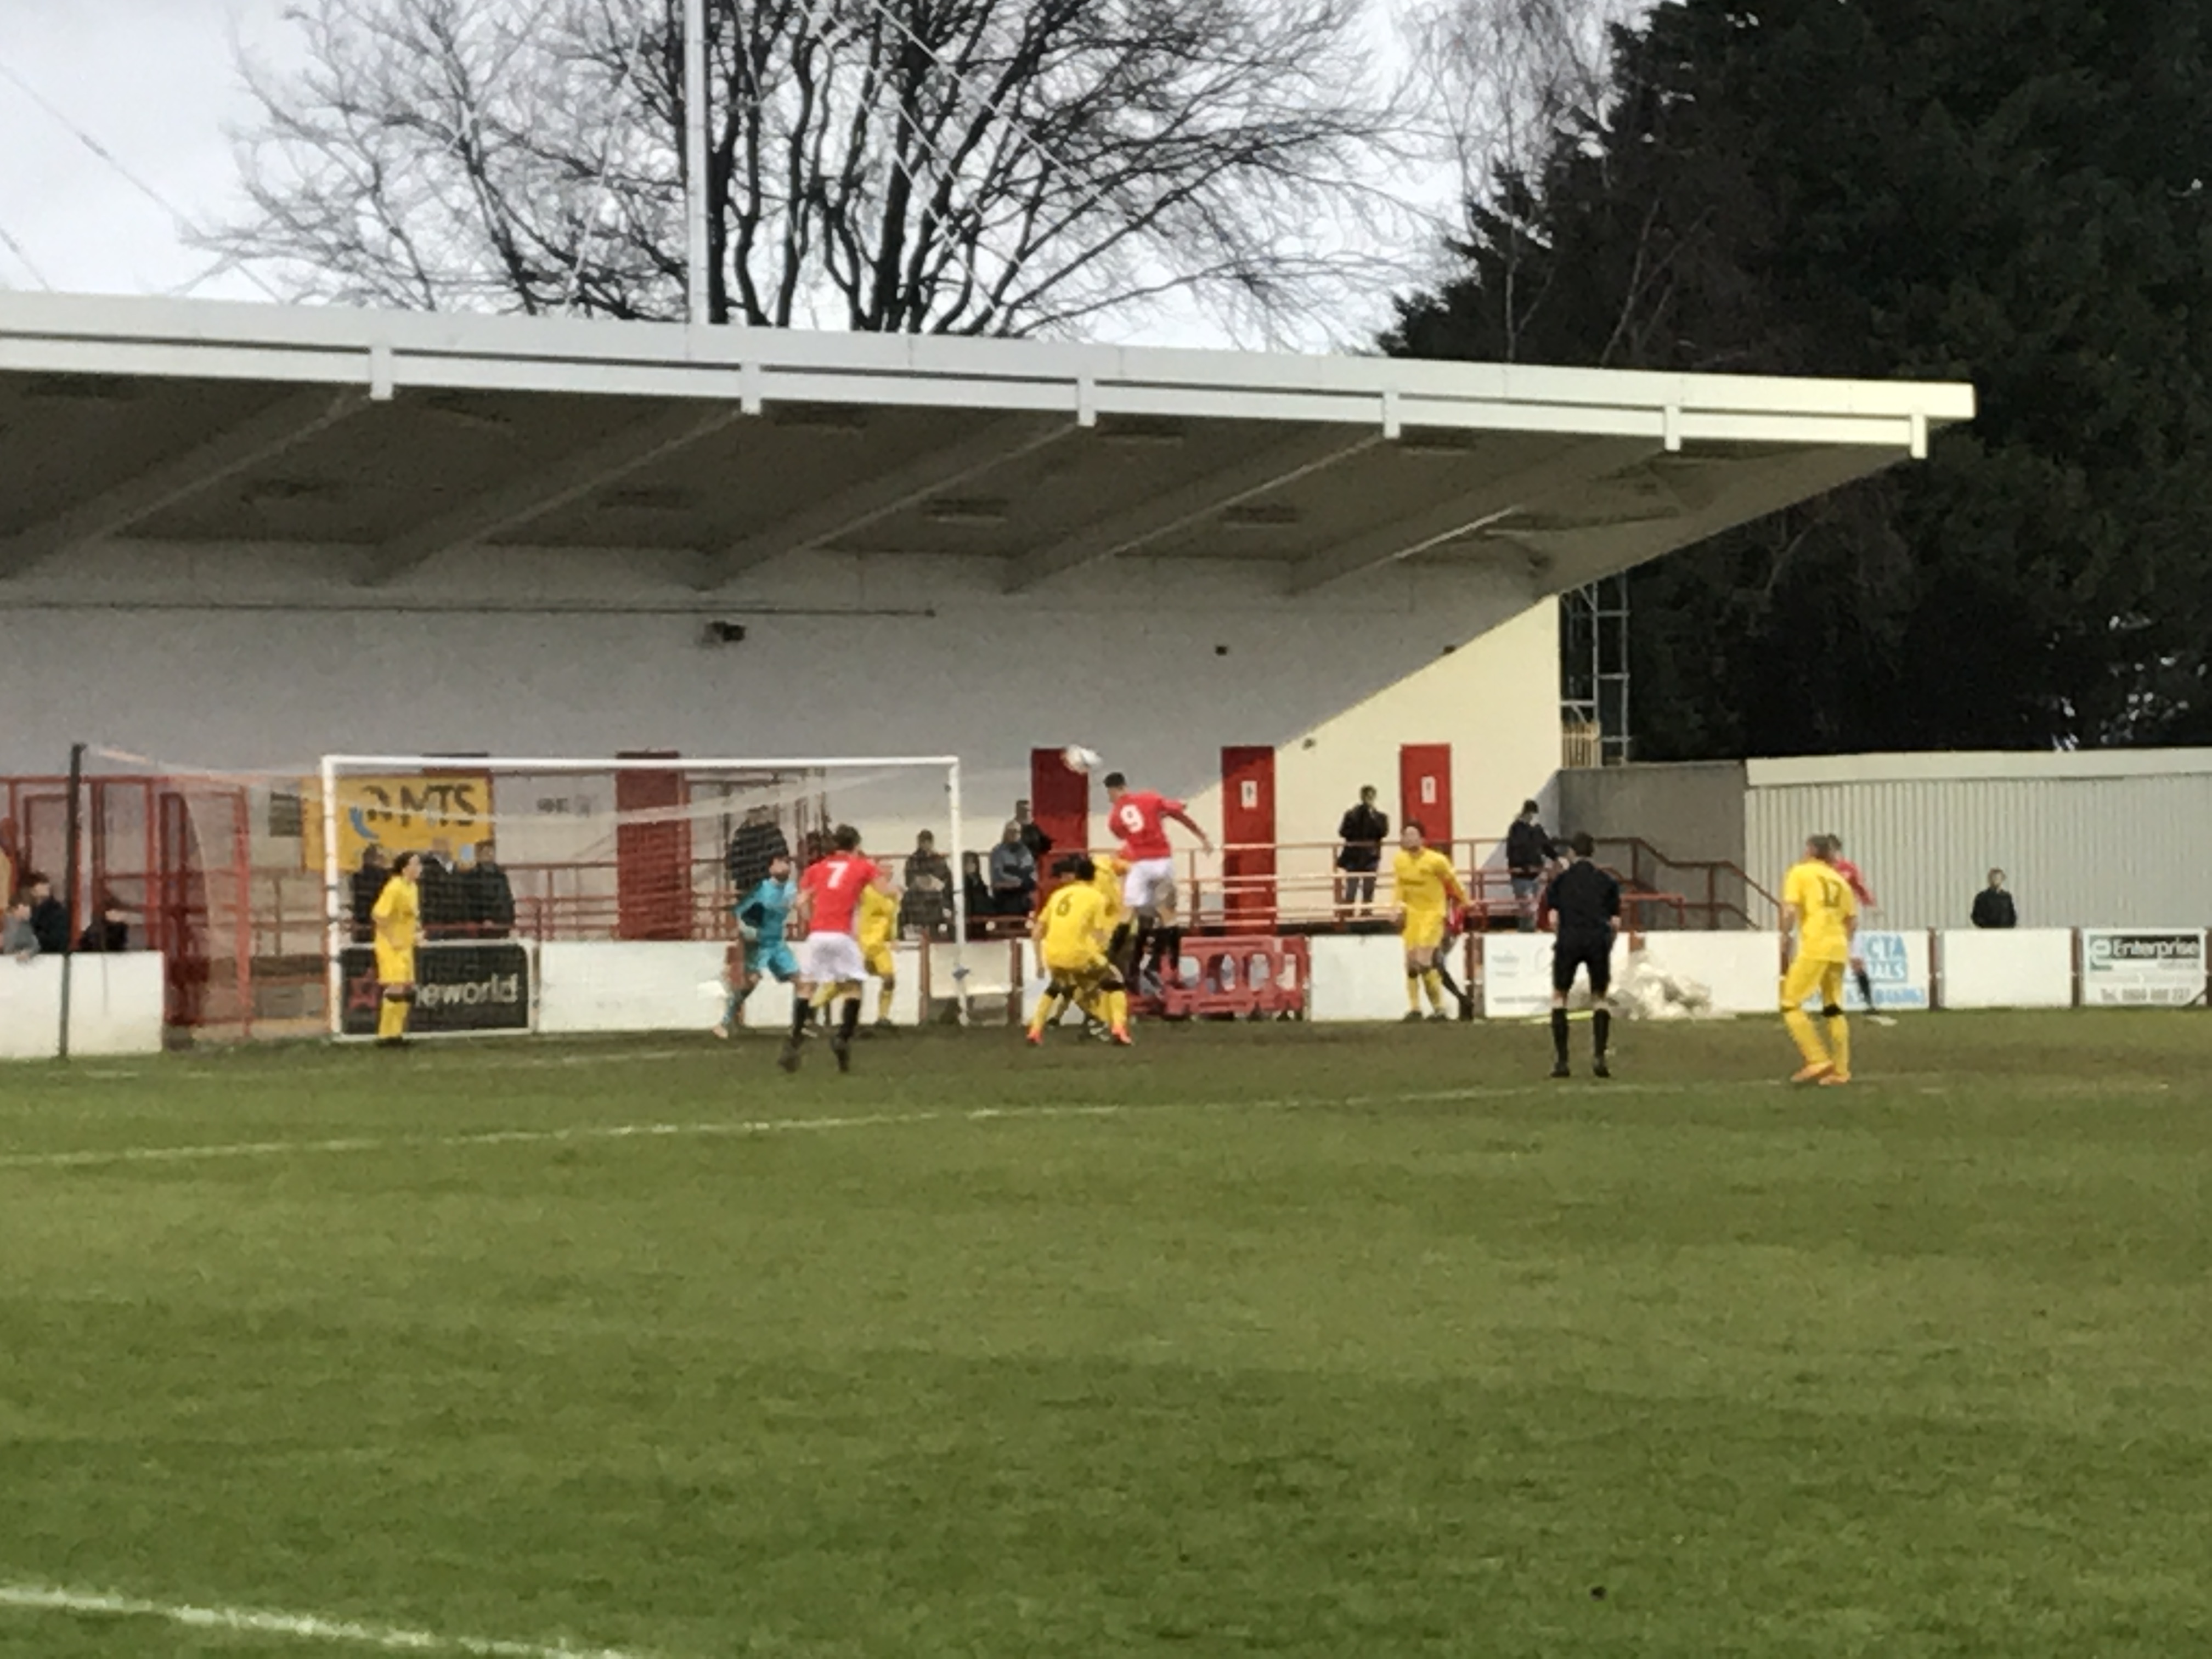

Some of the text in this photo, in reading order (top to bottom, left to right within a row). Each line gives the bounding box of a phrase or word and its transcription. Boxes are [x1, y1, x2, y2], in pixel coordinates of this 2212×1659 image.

[1120, 804, 1144, 833] 9
[826, 860, 849, 889] 7
[1055, 893, 1073, 917] 6
[415, 972, 517, 1008] eworld
